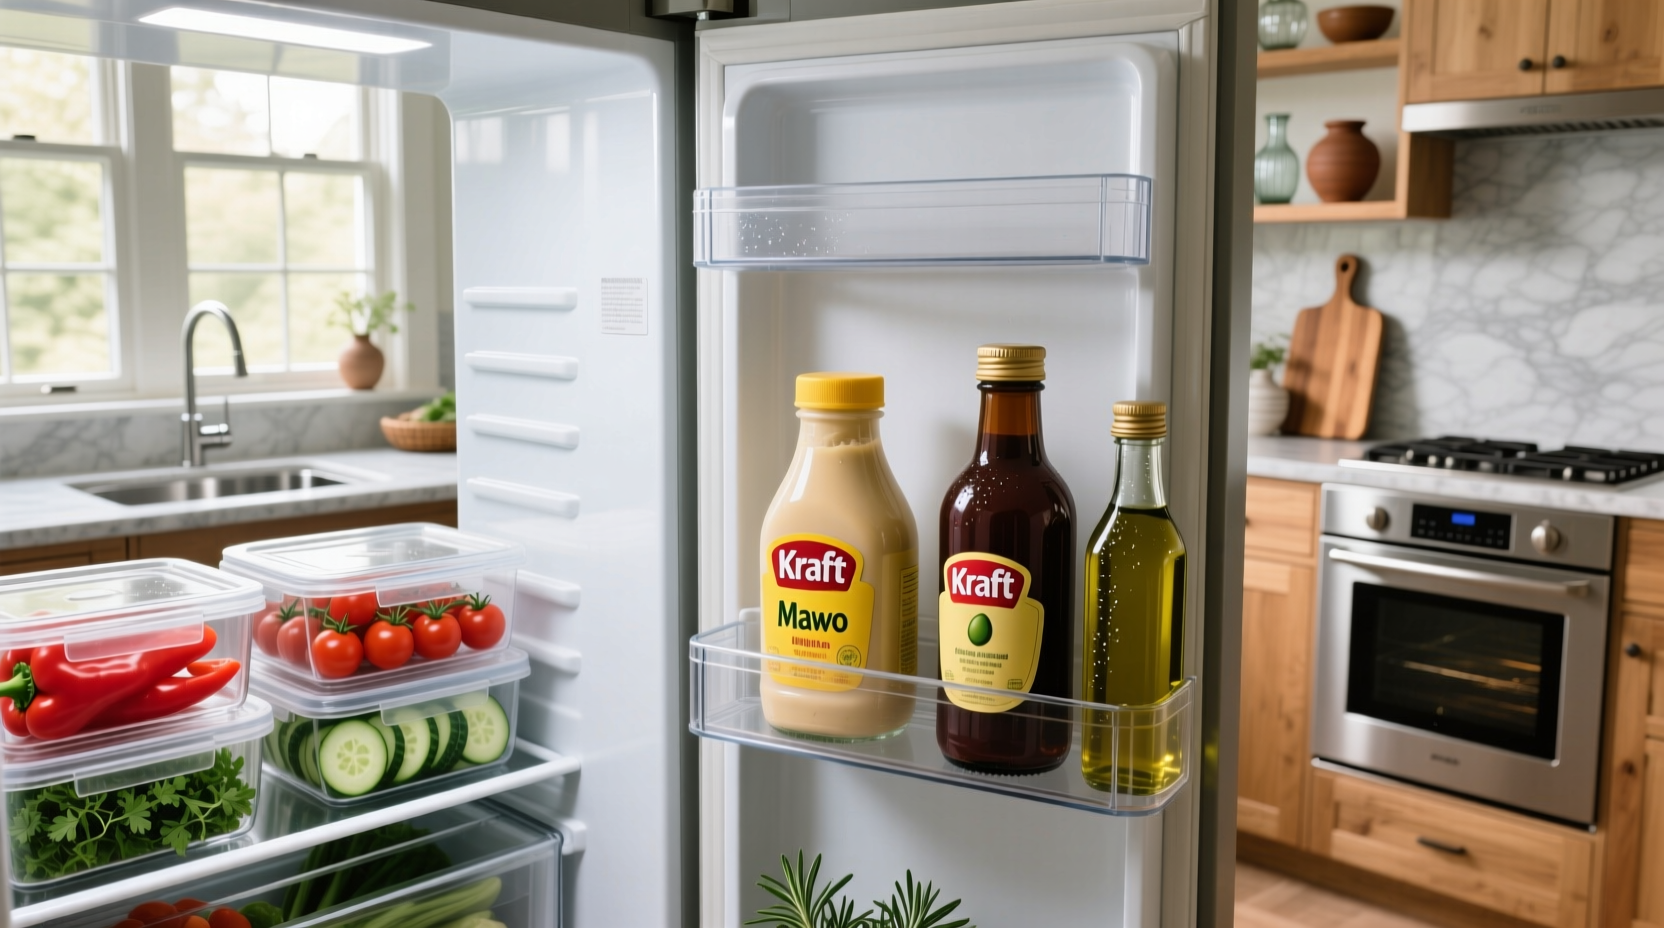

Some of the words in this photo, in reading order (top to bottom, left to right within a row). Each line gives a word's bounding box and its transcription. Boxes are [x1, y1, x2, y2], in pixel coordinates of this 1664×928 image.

[778, 549, 847, 584] Kraft
[951, 566, 1015, 600] Kraft
[777, 600, 848, 633] Mawo
